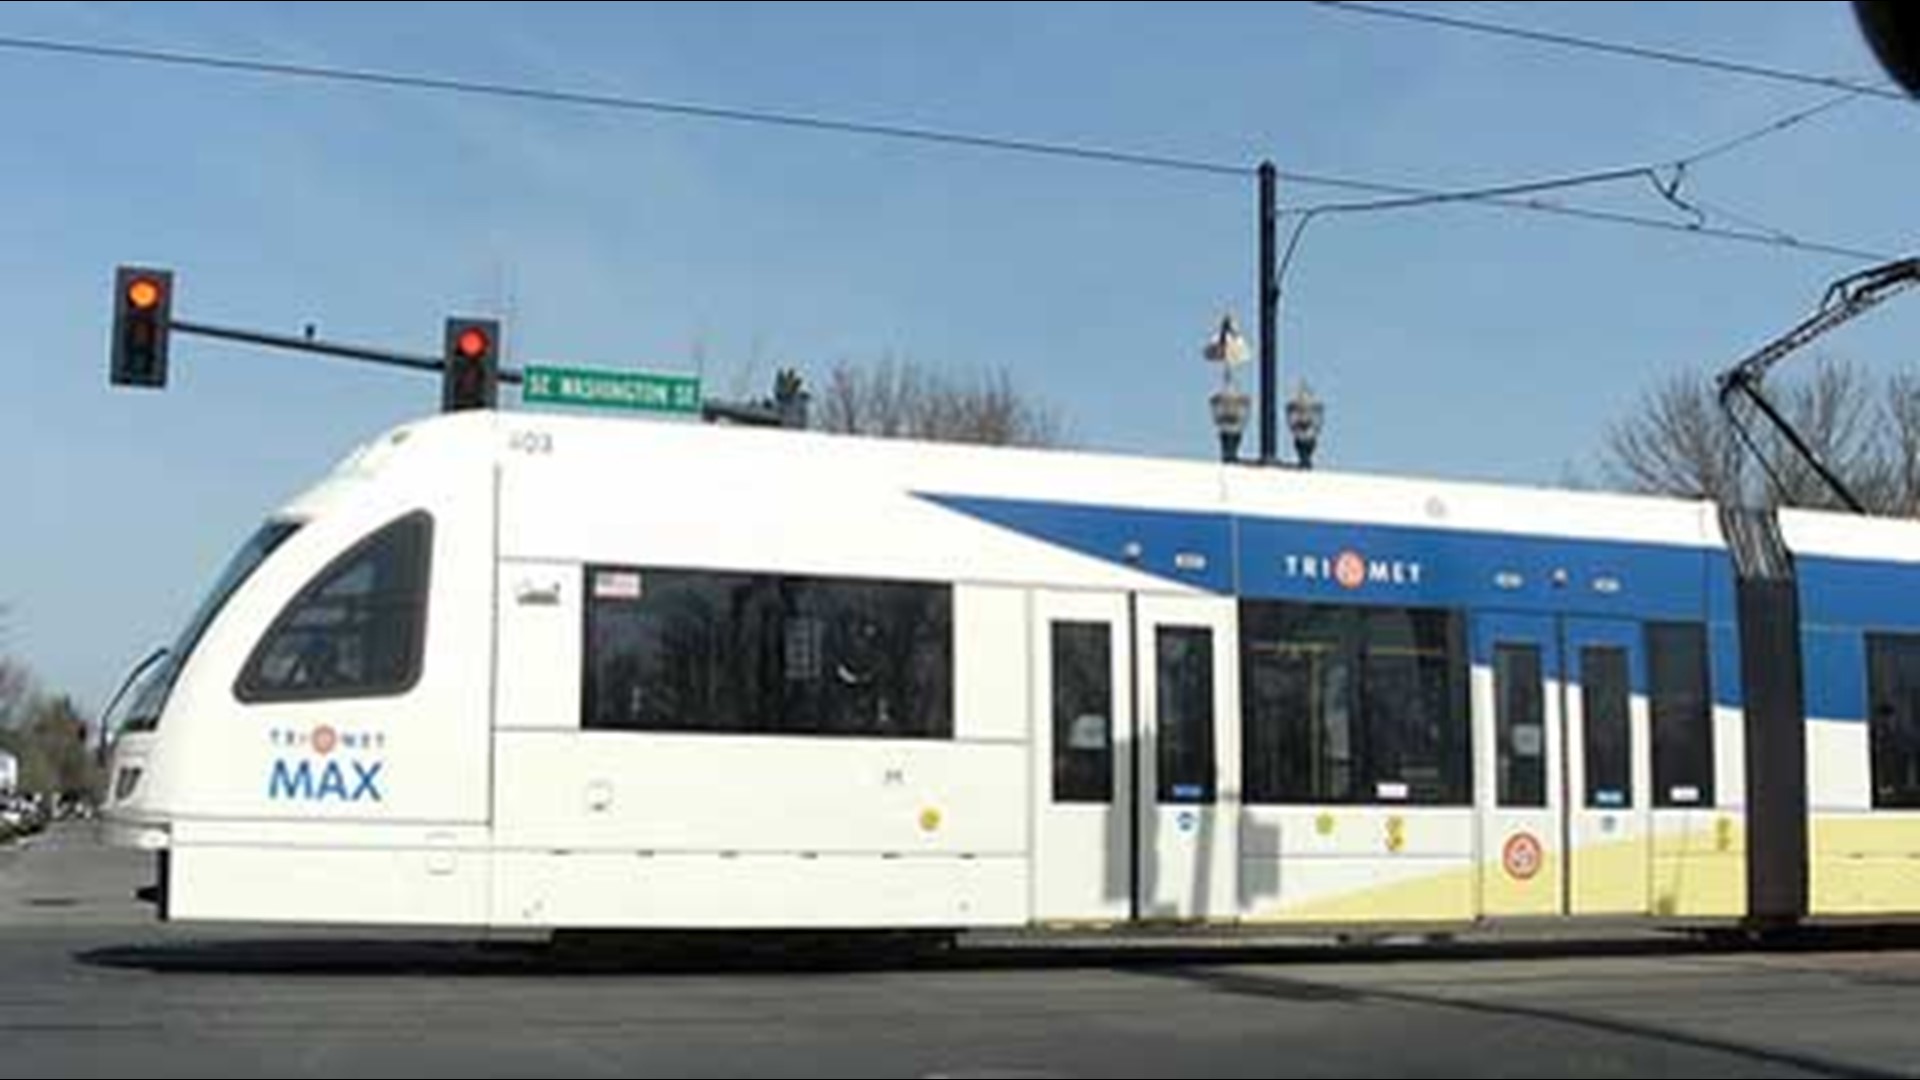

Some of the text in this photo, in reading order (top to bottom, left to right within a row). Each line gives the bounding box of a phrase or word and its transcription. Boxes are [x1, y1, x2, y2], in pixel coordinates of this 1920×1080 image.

[561, 377, 668, 405] WASHINGTON
[1286, 555, 1421, 583] TRI MET
[269, 759, 381, 800] MAX
